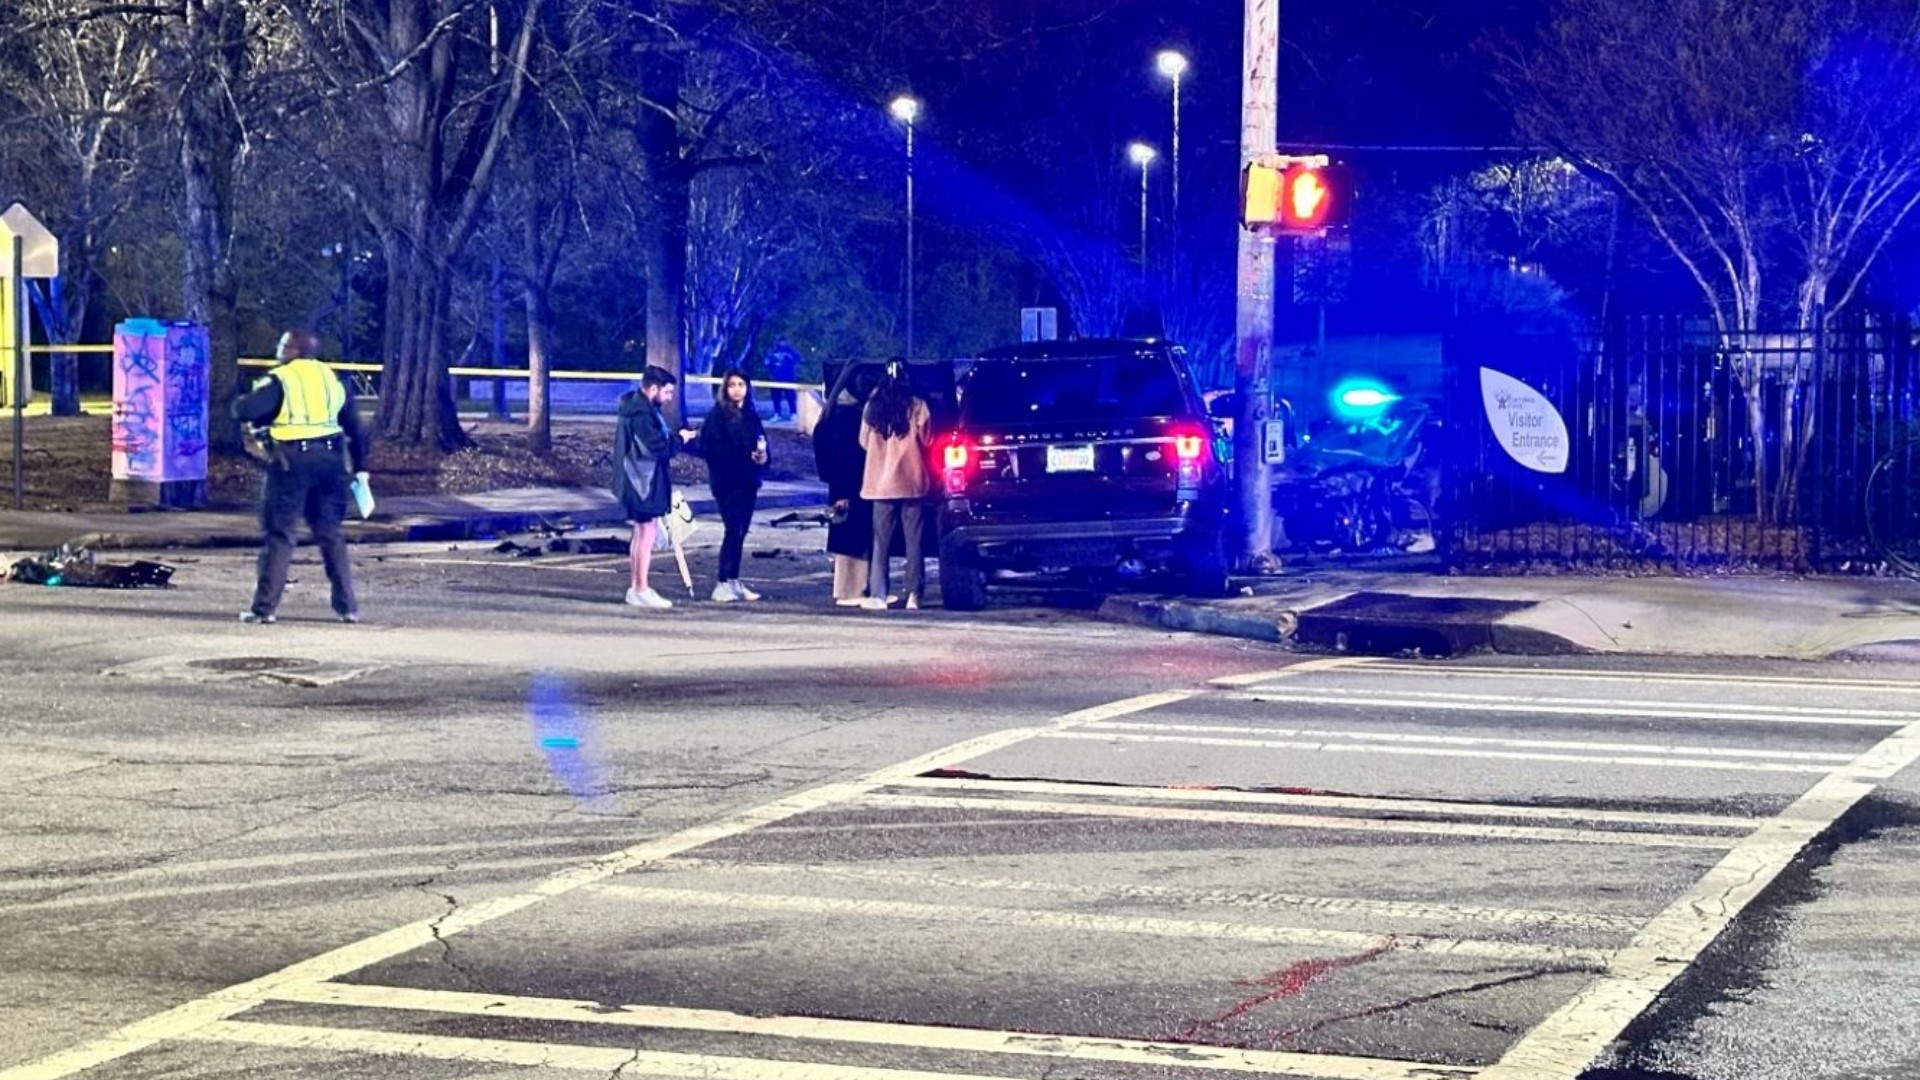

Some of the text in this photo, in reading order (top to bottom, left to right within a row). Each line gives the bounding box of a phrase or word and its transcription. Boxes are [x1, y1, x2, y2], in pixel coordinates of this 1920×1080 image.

[1509, 411, 1542, 428] Visitor
[1004, 429, 1135, 440] RANGE ROVER
[1512, 432, 1559, 448] Entrance
